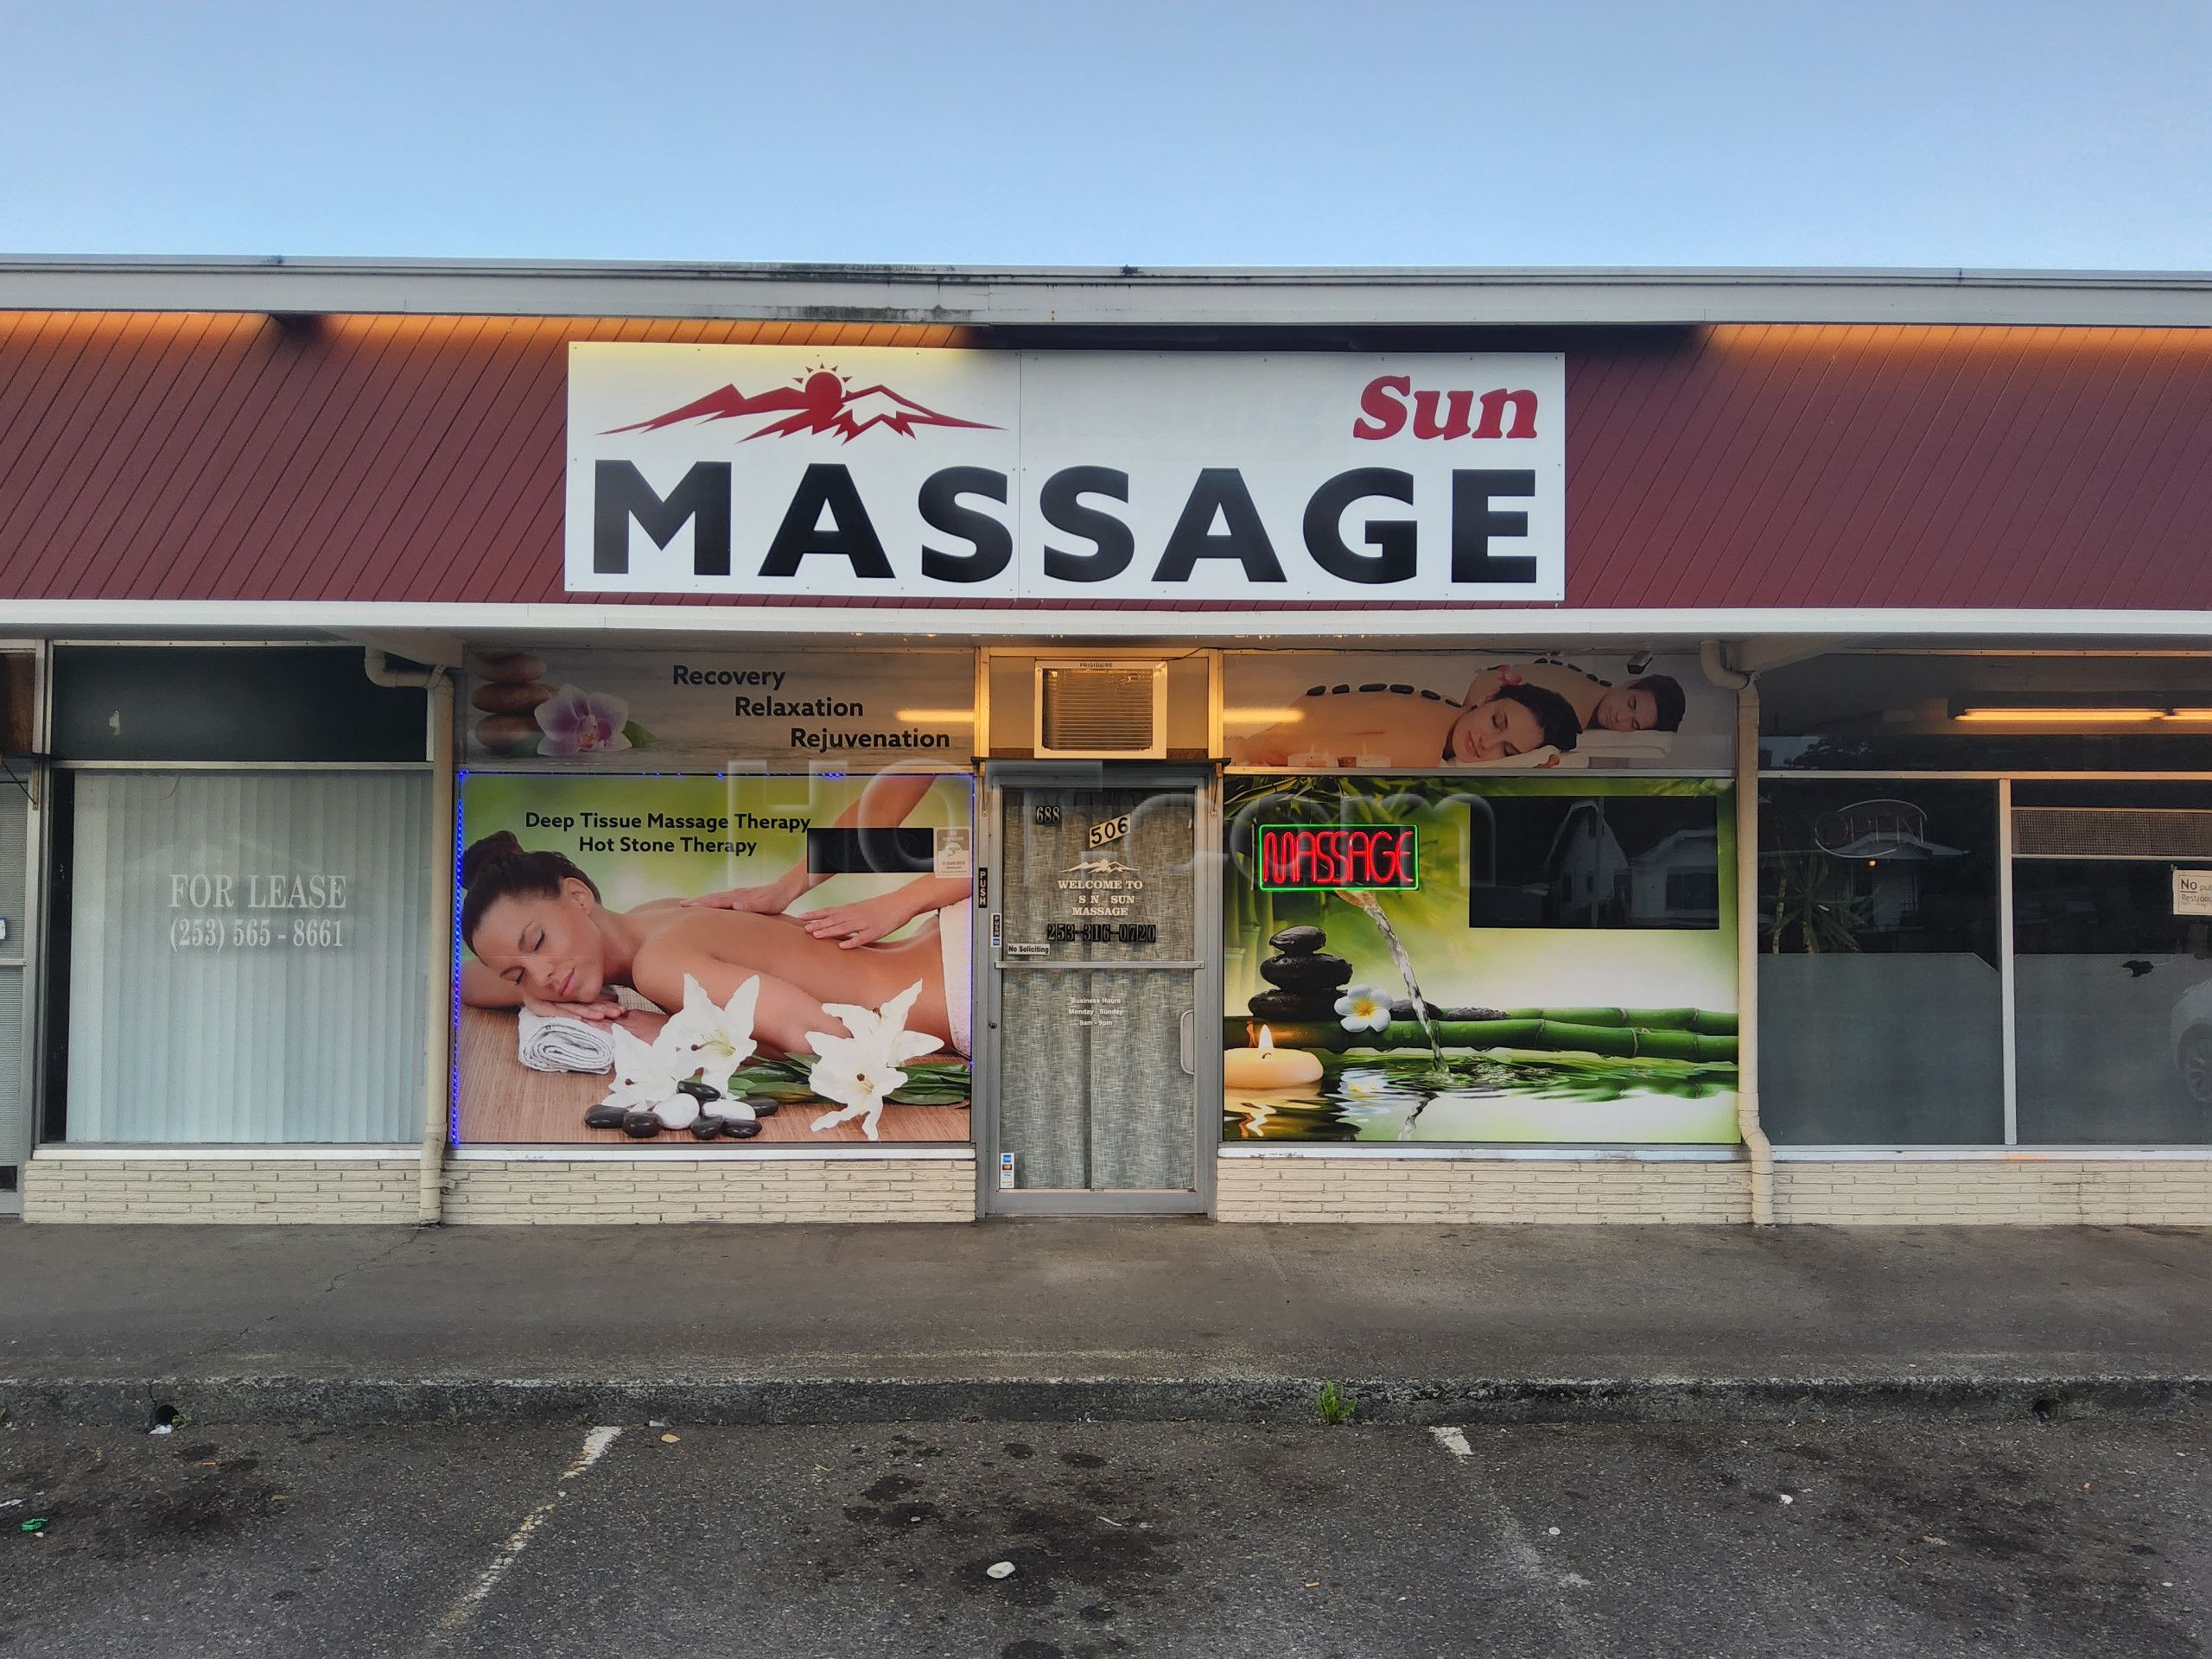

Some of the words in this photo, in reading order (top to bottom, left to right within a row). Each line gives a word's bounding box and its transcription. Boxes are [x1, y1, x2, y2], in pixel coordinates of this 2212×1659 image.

[1354, 374, 1538, 442] Sun
[594, 459, 1538, 584] MASSAGE
[673, 664, 785, 690] Recovery
[734, 696, 863, 717] Relaxation
[791, 728, 950, 753] Rejuvenation
[525, 811, 575, 831] Deep
[580, 811, 642, 829] Tissue
[648, 812, 729, 833] Massage
[734, 813, 810, 833] Therapy
[1037, 806, 1060, 823] 688
[1090, 817, 1128, 845] 506
[579, 836, 614, 853] Hot
[620, 836, 675, 853] Stone
[680, 836, 757, 856] Therapy
[1262, 830, 1415, 884] MASSAGE
[168, 874, 235, 908] FOR
[248, 874, 346, 908] LEASE
[1057, 880, 1122, 890] WELCOME
[1126, 880, 1143, 890] TO
[2180, 879, 2197, 891] No
[1110, 895, 1135, 904] SUN
[1071, 907, 1128, 916] MASSAGE
[170, 917, 226, 953] (253)
[232, 918, 270, 947] 565
[293, 918, 344, 947] 8661
[1047, 924, 1156, 942] 253-316-0720
[1019, 945, 1049, 954] Soliciting
